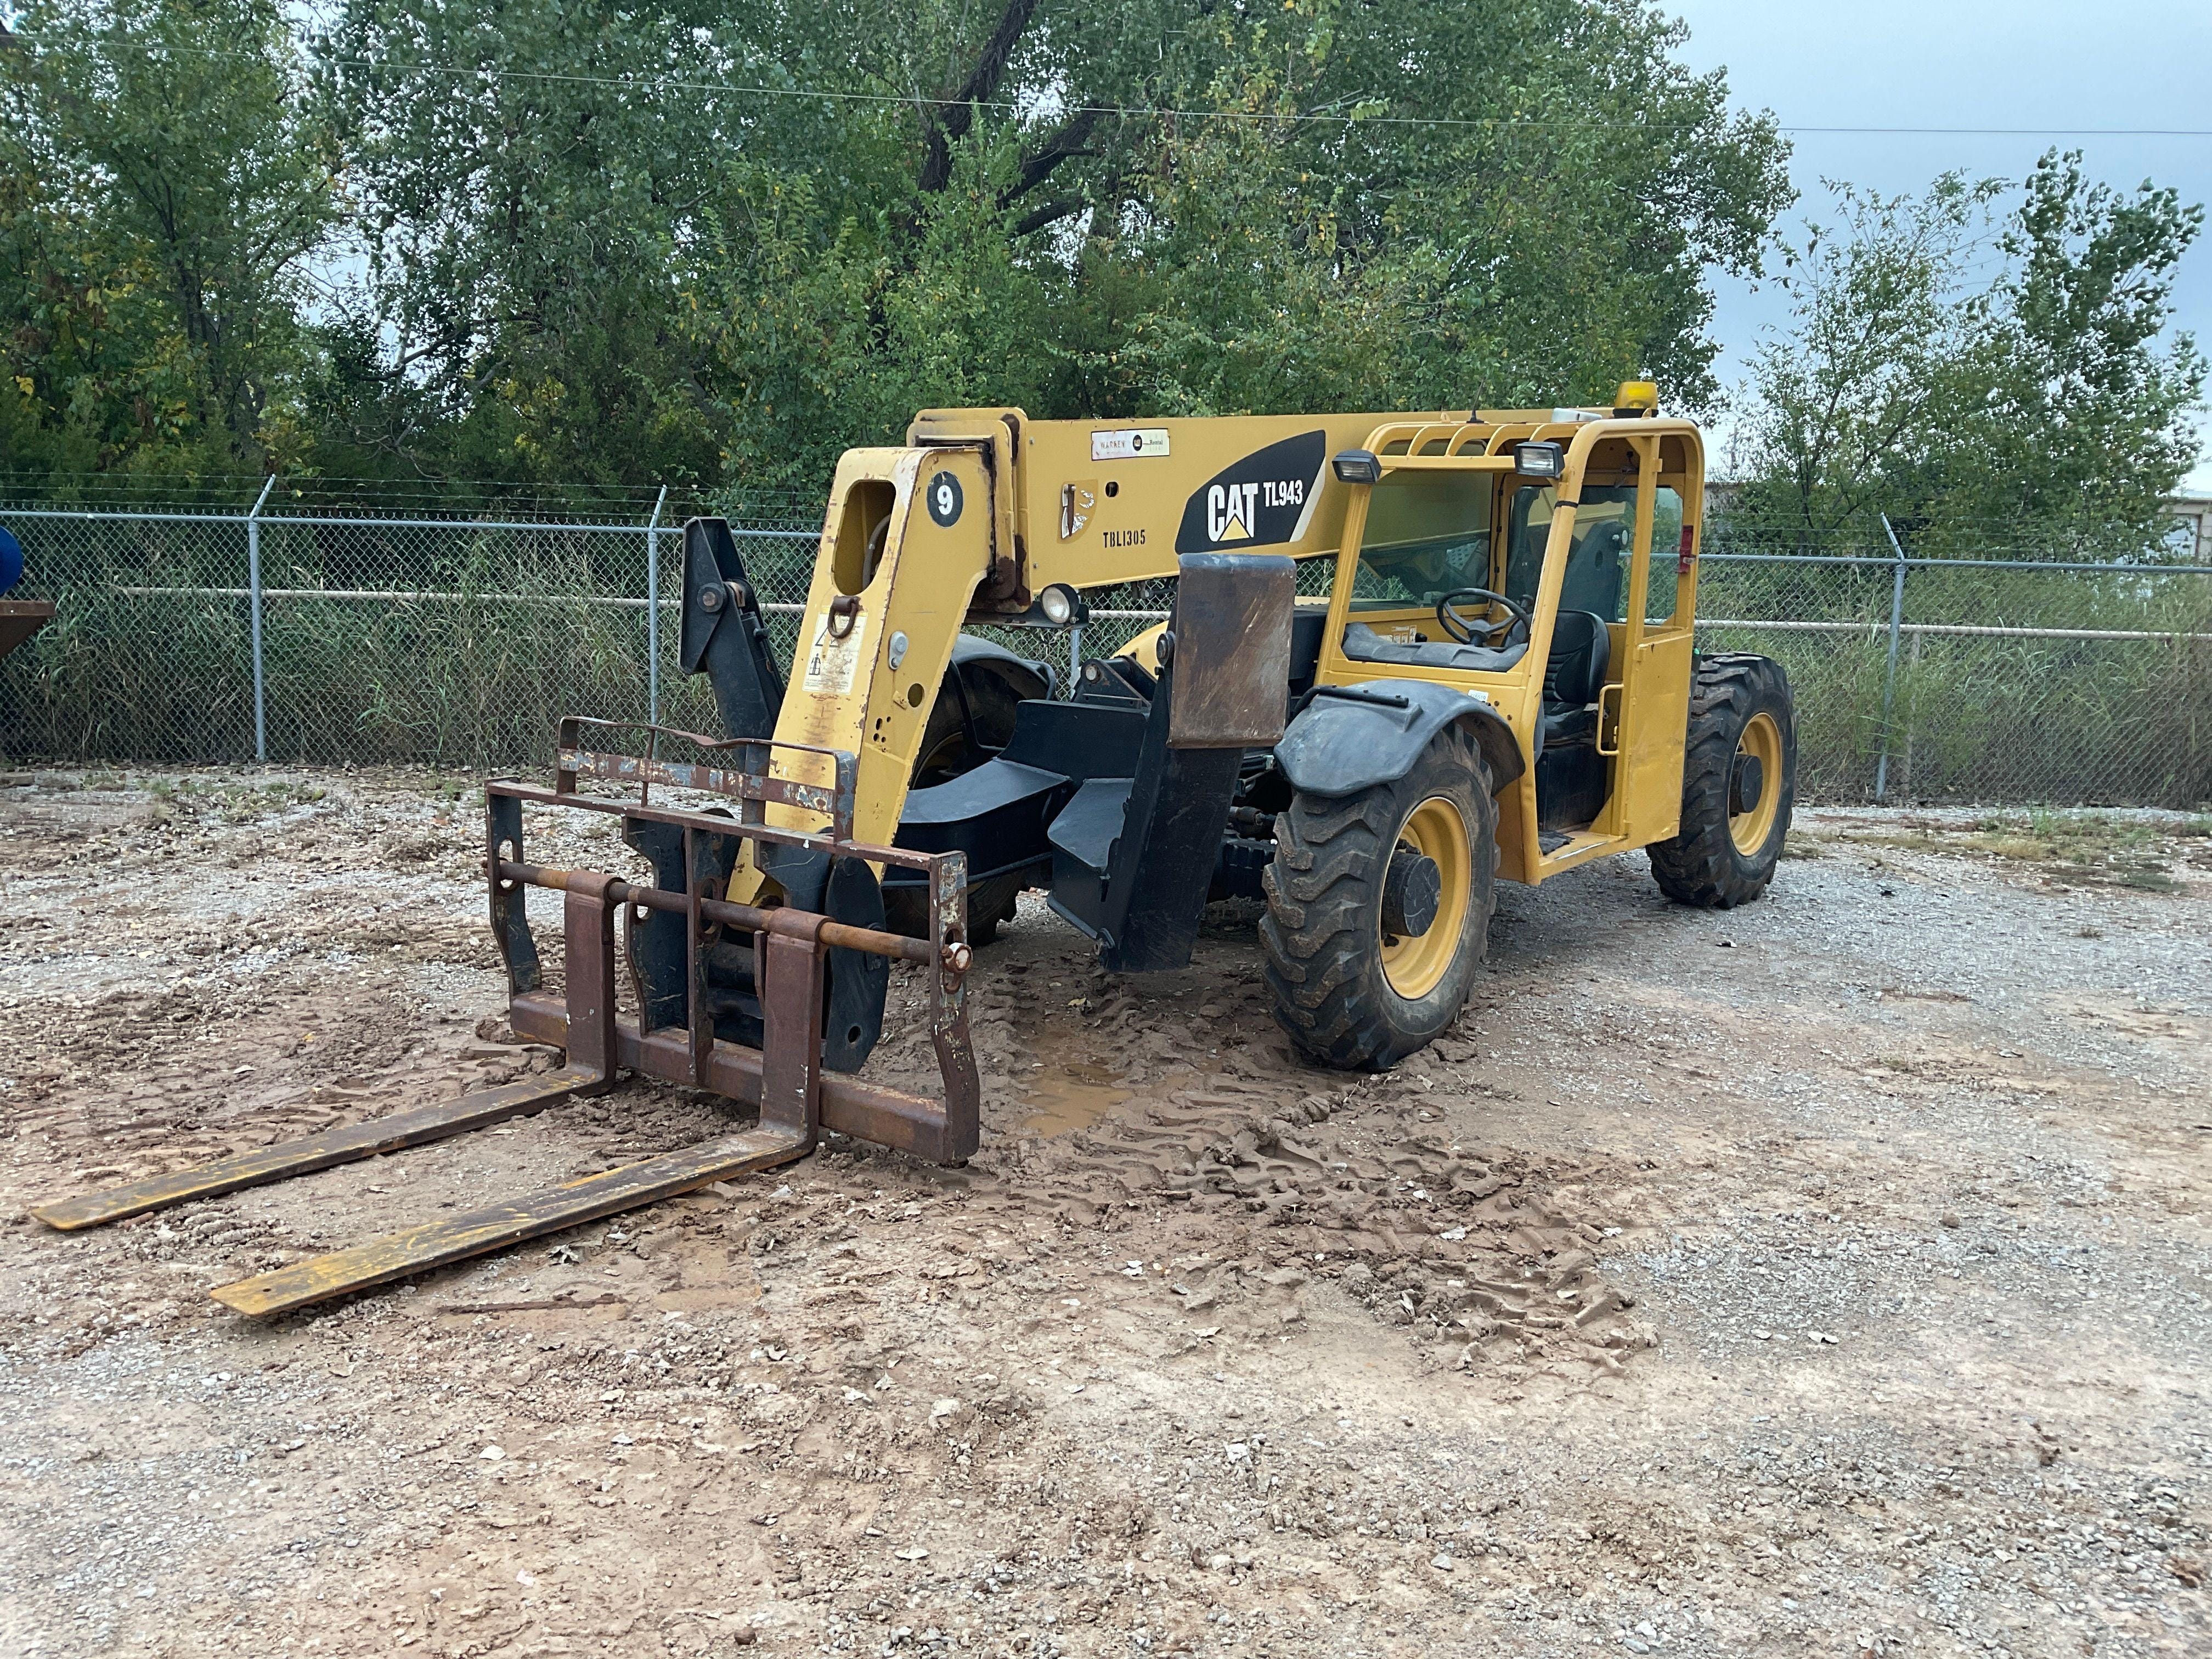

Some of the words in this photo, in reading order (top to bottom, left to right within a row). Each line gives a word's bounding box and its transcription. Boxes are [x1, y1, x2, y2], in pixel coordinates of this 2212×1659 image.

[1101, 440, 1125, 449] WARREN
[937, 485, 953, 515] 9
[1207, 483, 1258, 542] CAT
[1263, 479, 1303, 507] TL943
[1103, 529, 1146, 548] TBL1305
